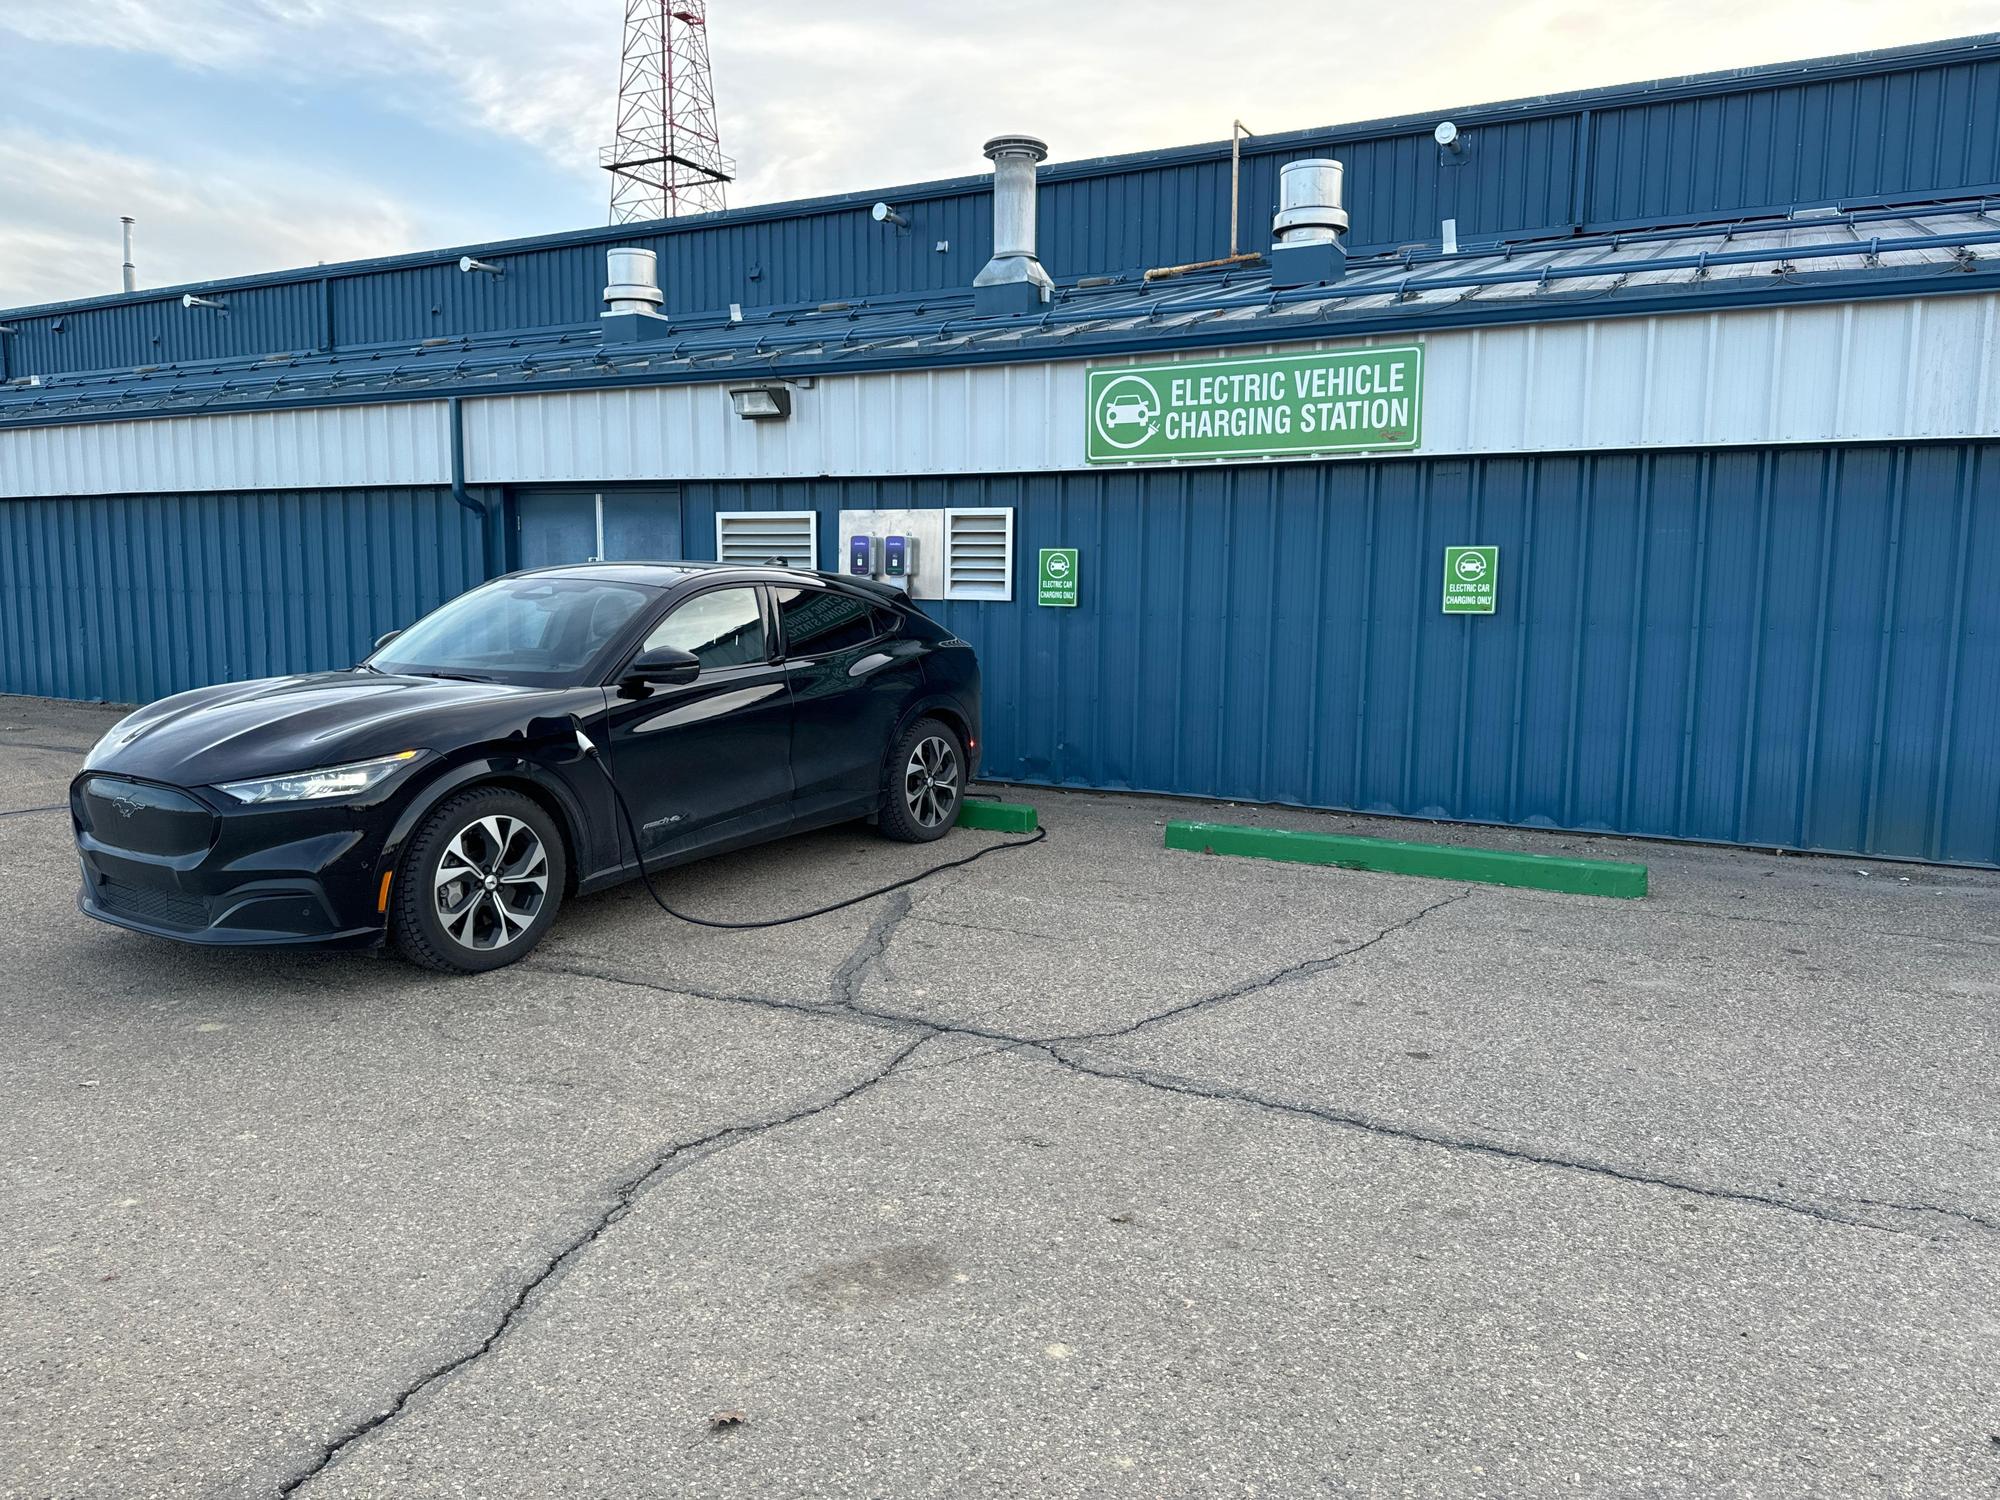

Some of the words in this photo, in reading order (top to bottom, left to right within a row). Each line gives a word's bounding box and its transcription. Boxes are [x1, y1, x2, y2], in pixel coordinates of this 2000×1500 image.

[1171, 372, 1285, 407] ELECTRIC
[1294, 362, 1405, 399] VEHICLE
[1165, 405, 1291, 440] CHARGING
[1300, 397, 1409, 433] STATION
[1043, 580, 1062, 588] ELECTRIC
[1063, 580, 1072, 588] CAR
[1449, 584, 1477, 592] ELECTRIC
[1477, 584, 1490, 592] CAR
[1040, 591, 1062, 599] CHARGING
[1063, 591, 1074, 599] ONLY
[1446, 595, 1476, 604] CHARGING
[1477, 595, 1492, 604] ONLY
